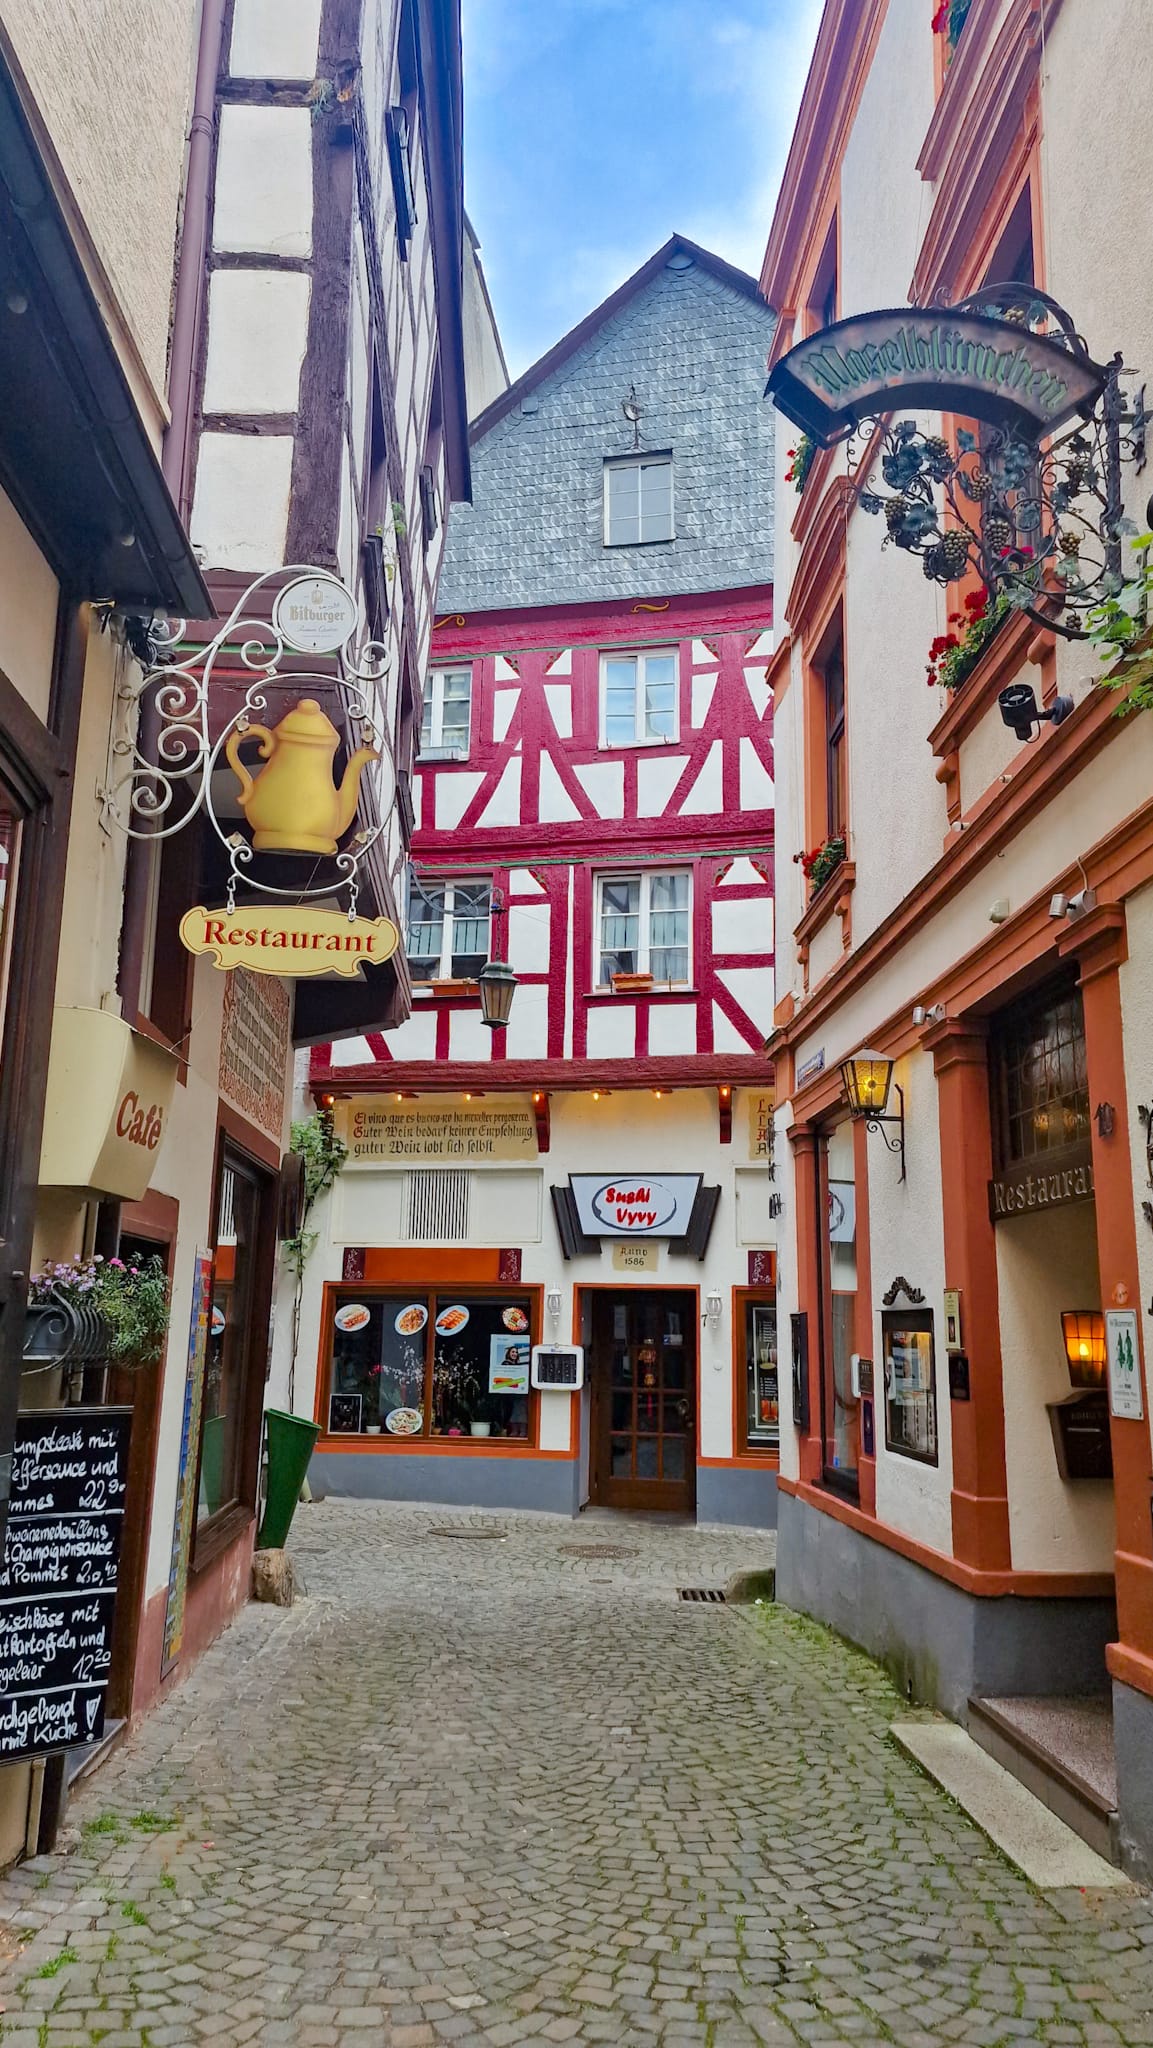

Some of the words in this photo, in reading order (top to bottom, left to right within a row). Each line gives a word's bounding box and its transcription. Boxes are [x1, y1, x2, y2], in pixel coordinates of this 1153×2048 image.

[289, 606, 346, 623] Bitburger
[203, 919, 377, 953] Restaurant
[389, 1113, 404, 1125] que
[406, 1113, 415, 1124] es
[353, 1126, 383, 1139] Guter
[385, 1126, 414, 1138] Wein
[416, 1124, 448, 1138] bedarf
[449, 1124, 477, 1138] keiner
[354, 1141, 385, 1158] guter
[389, 1140, 421, 1154] Wein
[424, 1139, 443, 1153] lobt
[605, 1187, 651, 1205] Sushi
[616, 1208, 657, 1226] Vyvy
[624, 1257, 645, 1266] 1586
[701, 1314, 708, 1327] 7
[88, 1428, 117, 1449] mit
[91, 1451, 118, 1476] und
[11, 1562, 69, 1584] Pommes
[71, 1599, 100, 1623] mit
[80, 1624, 106, 1648] und
